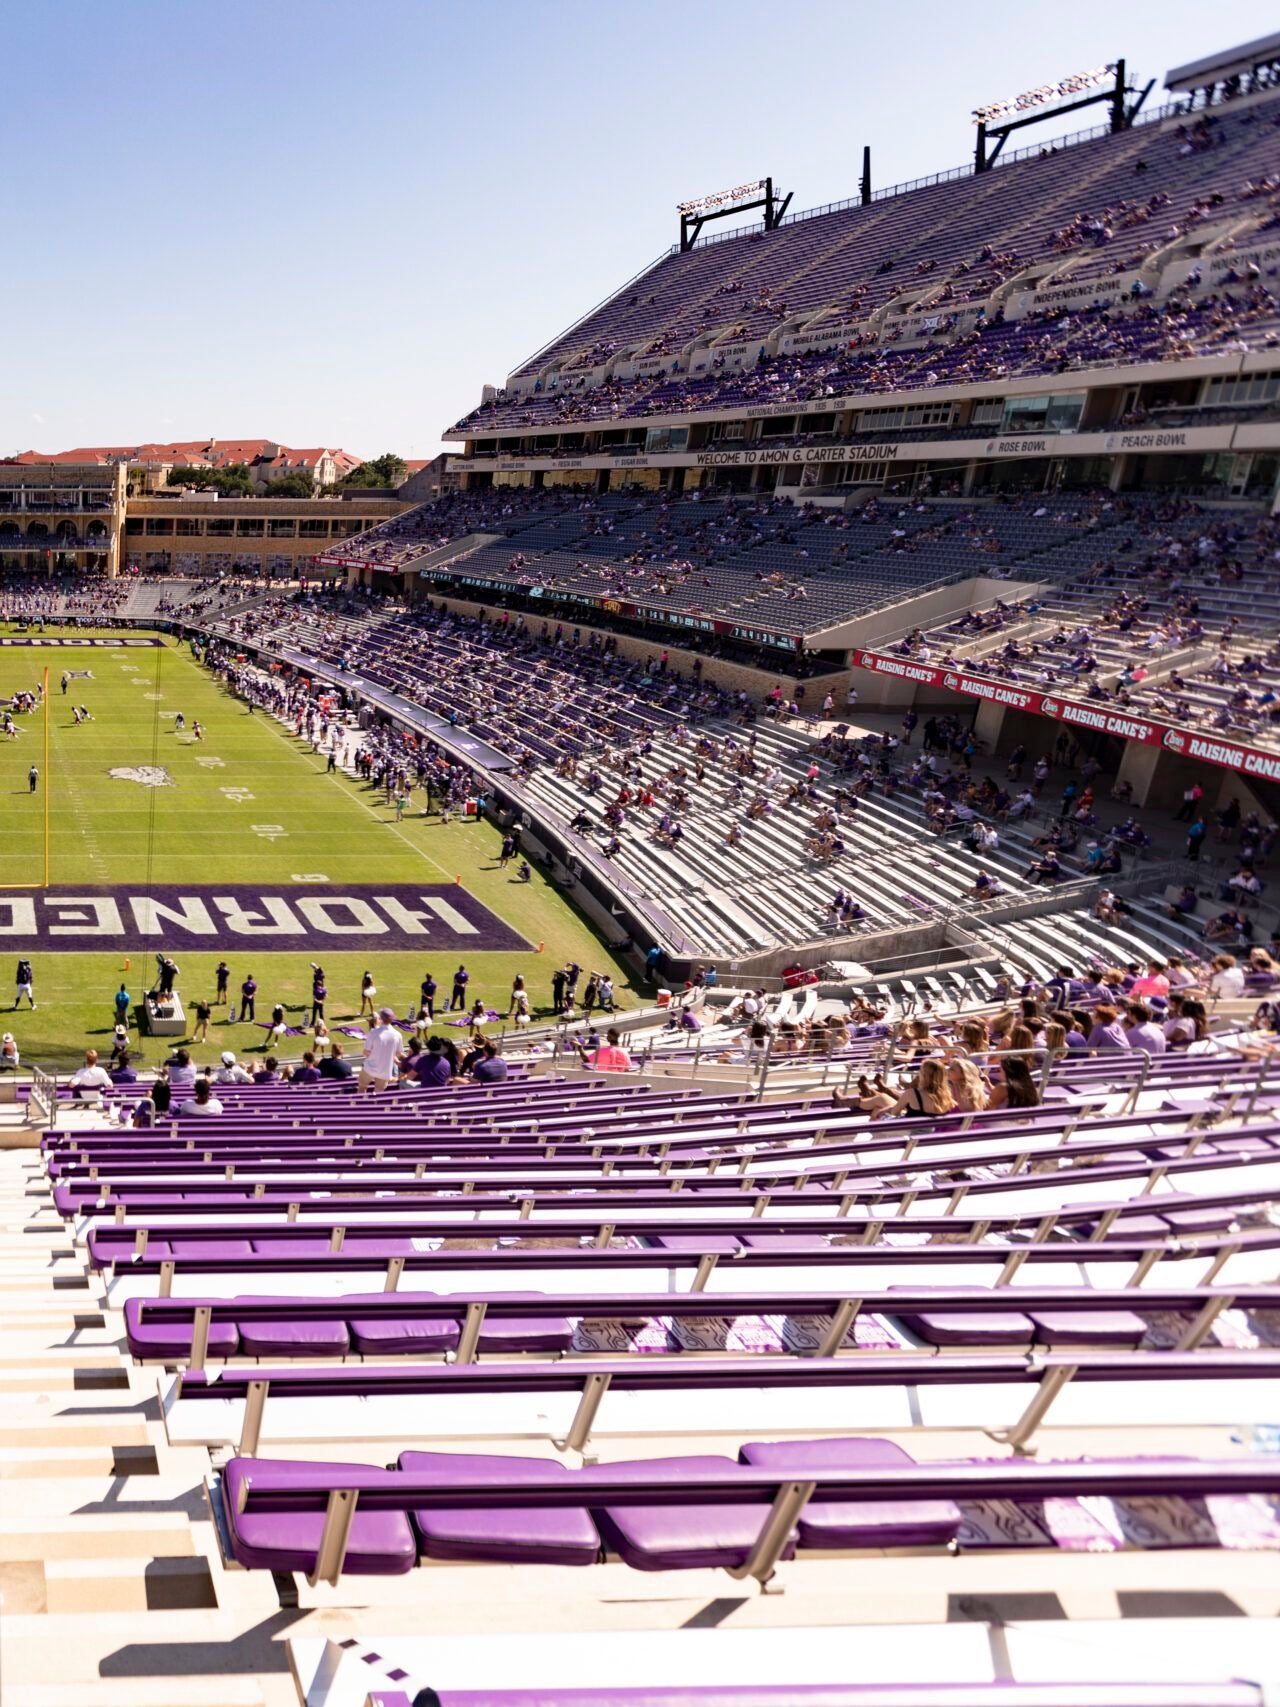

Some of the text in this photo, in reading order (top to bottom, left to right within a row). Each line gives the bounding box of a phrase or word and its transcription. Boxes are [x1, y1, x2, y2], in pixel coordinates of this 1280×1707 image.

[1034, 280, 1120, 304] INDEPENDENCE BOWL
[884, 320, 900, 331] HOME
[793, 327, 860, 346] MOBILE ALABAMA BOWL
[733, 346, 747, 356] BOWL
[747, 405, 773, 416] NATIONAL
[773, 403, 808, 415] CHAMPIONS
[998, 440, 1046, 452] ROSE BOWL
[1121, 433, 1186, 447] PEACH BOWL
[697, 445, 898, 464] WELCOME TO AMON G. CARTER STADIUM
[2, 638, 154, 647] FROGS
[875, 659, 906, 675] RAISING
[960, 680, 995, 698] RAISING
[1062, 705, 1106, 728] RAISING
[1189, 738, 1244, 768] RAISING
[220, 787, 256, 800] 20
[250, 824, 290, 837] 10
